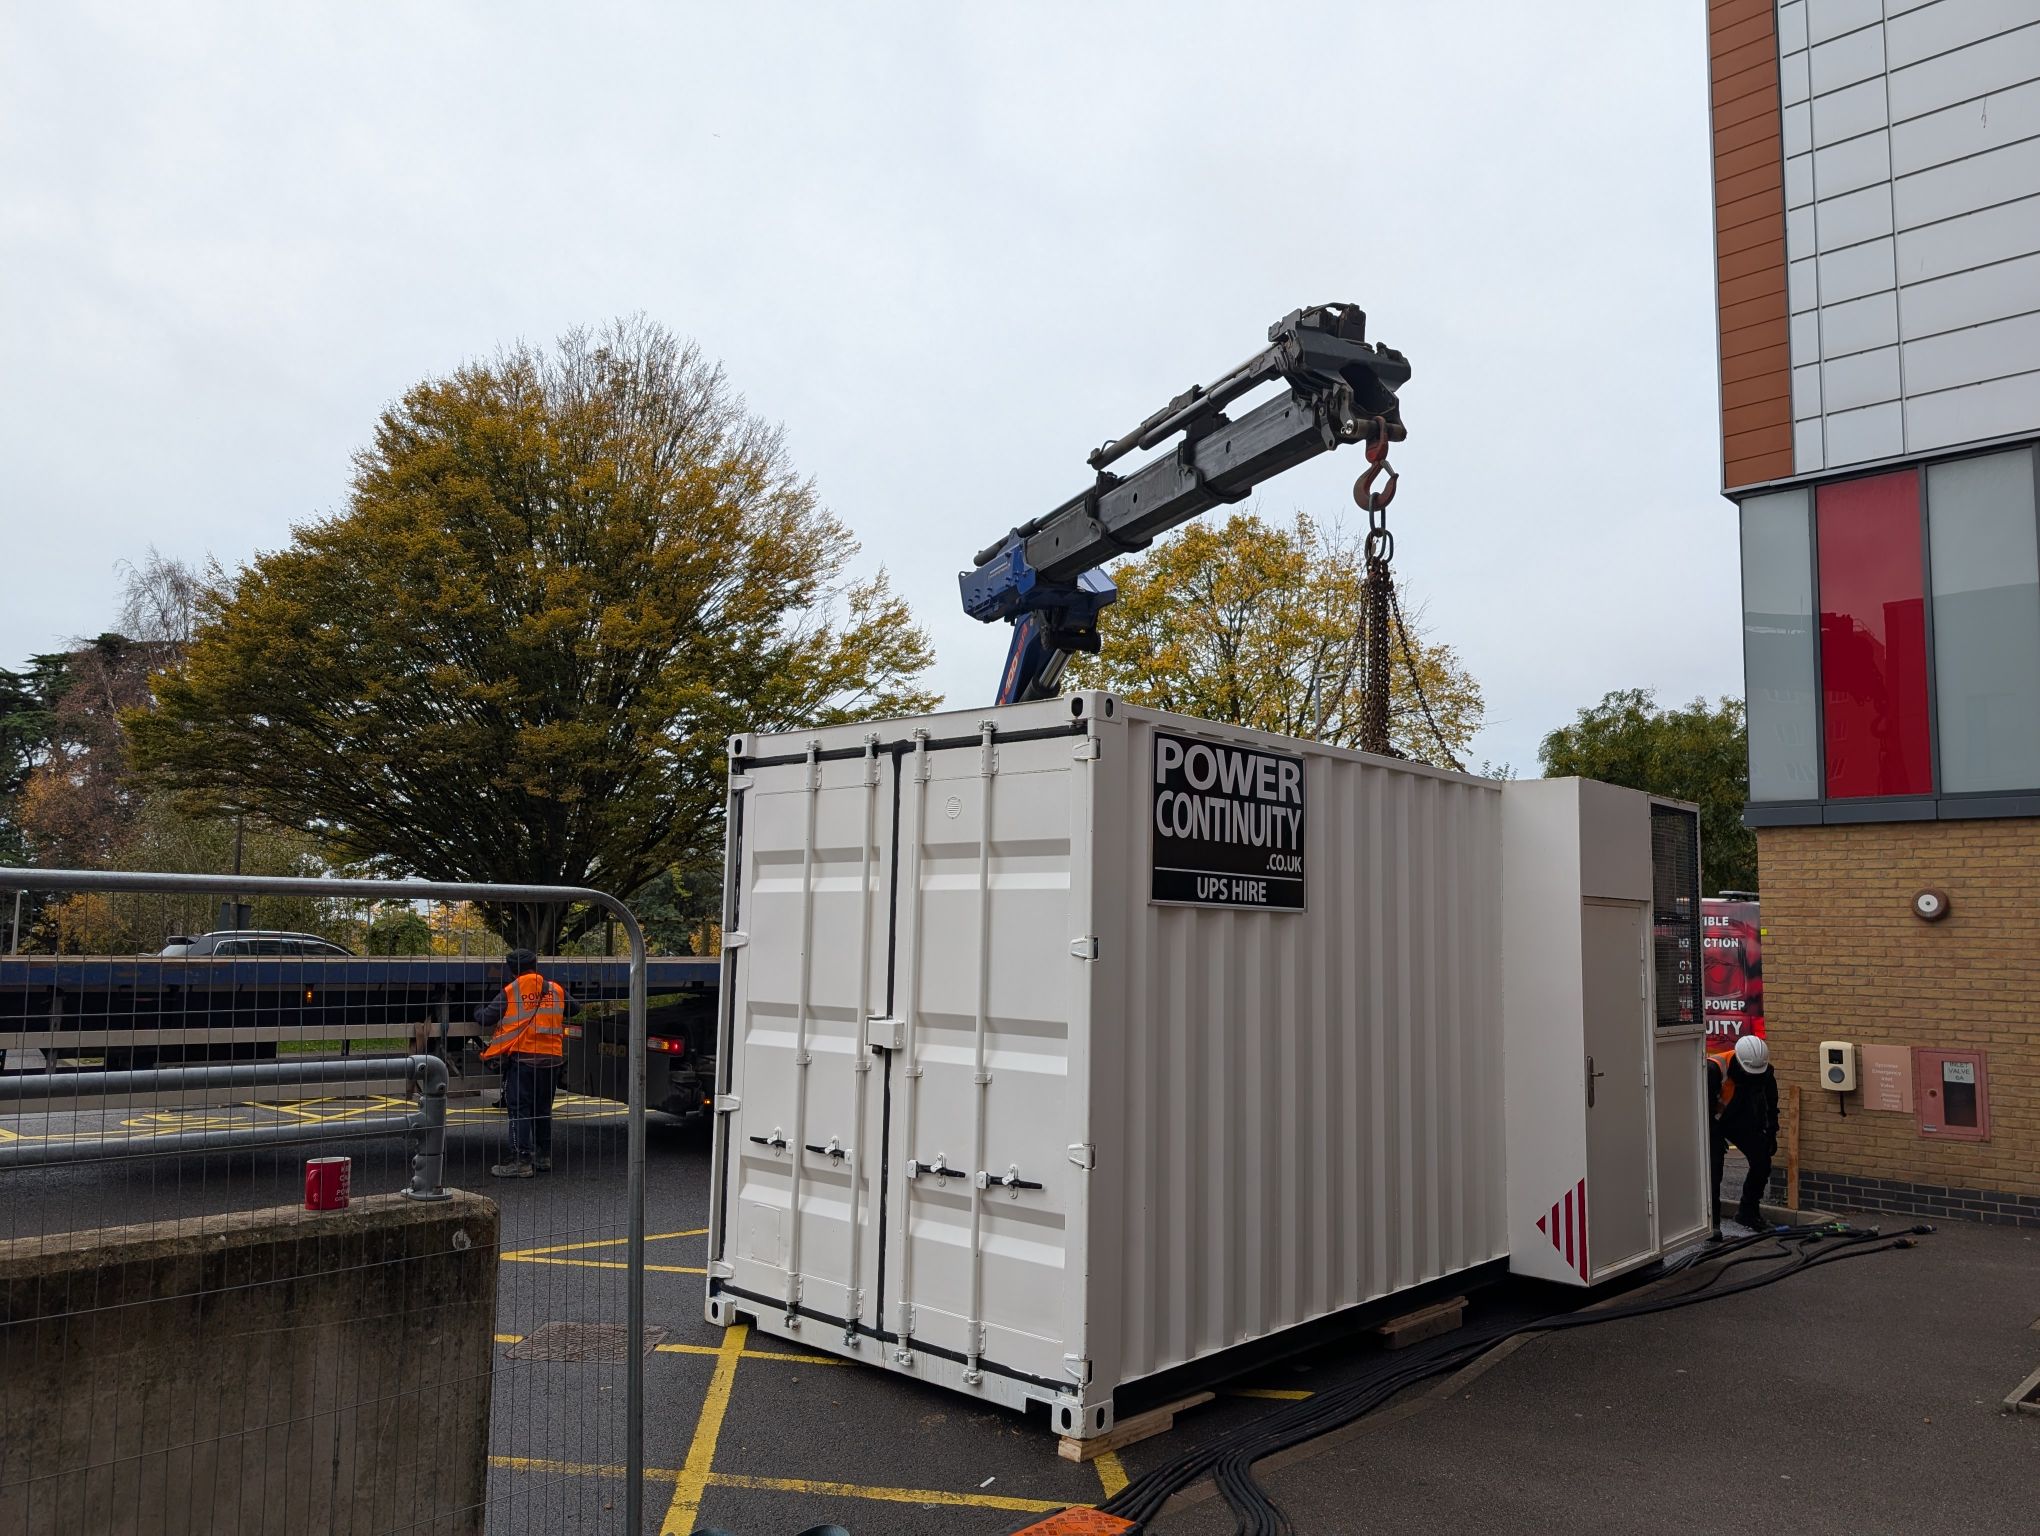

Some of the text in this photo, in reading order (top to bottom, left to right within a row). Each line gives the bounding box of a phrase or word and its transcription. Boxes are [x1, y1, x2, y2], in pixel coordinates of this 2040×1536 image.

[1157, 737, 1302, 804] POWER
[1156, 790, 1302, 850] CONTINUITY
[1266, 853, 1302, 873] .CO.UK
[1197, 876, 1267, 903] UPS HIRE
[1702, 916, 1729, 926] IBLE
[1948, 1067, 1970, 1075] VALVE
